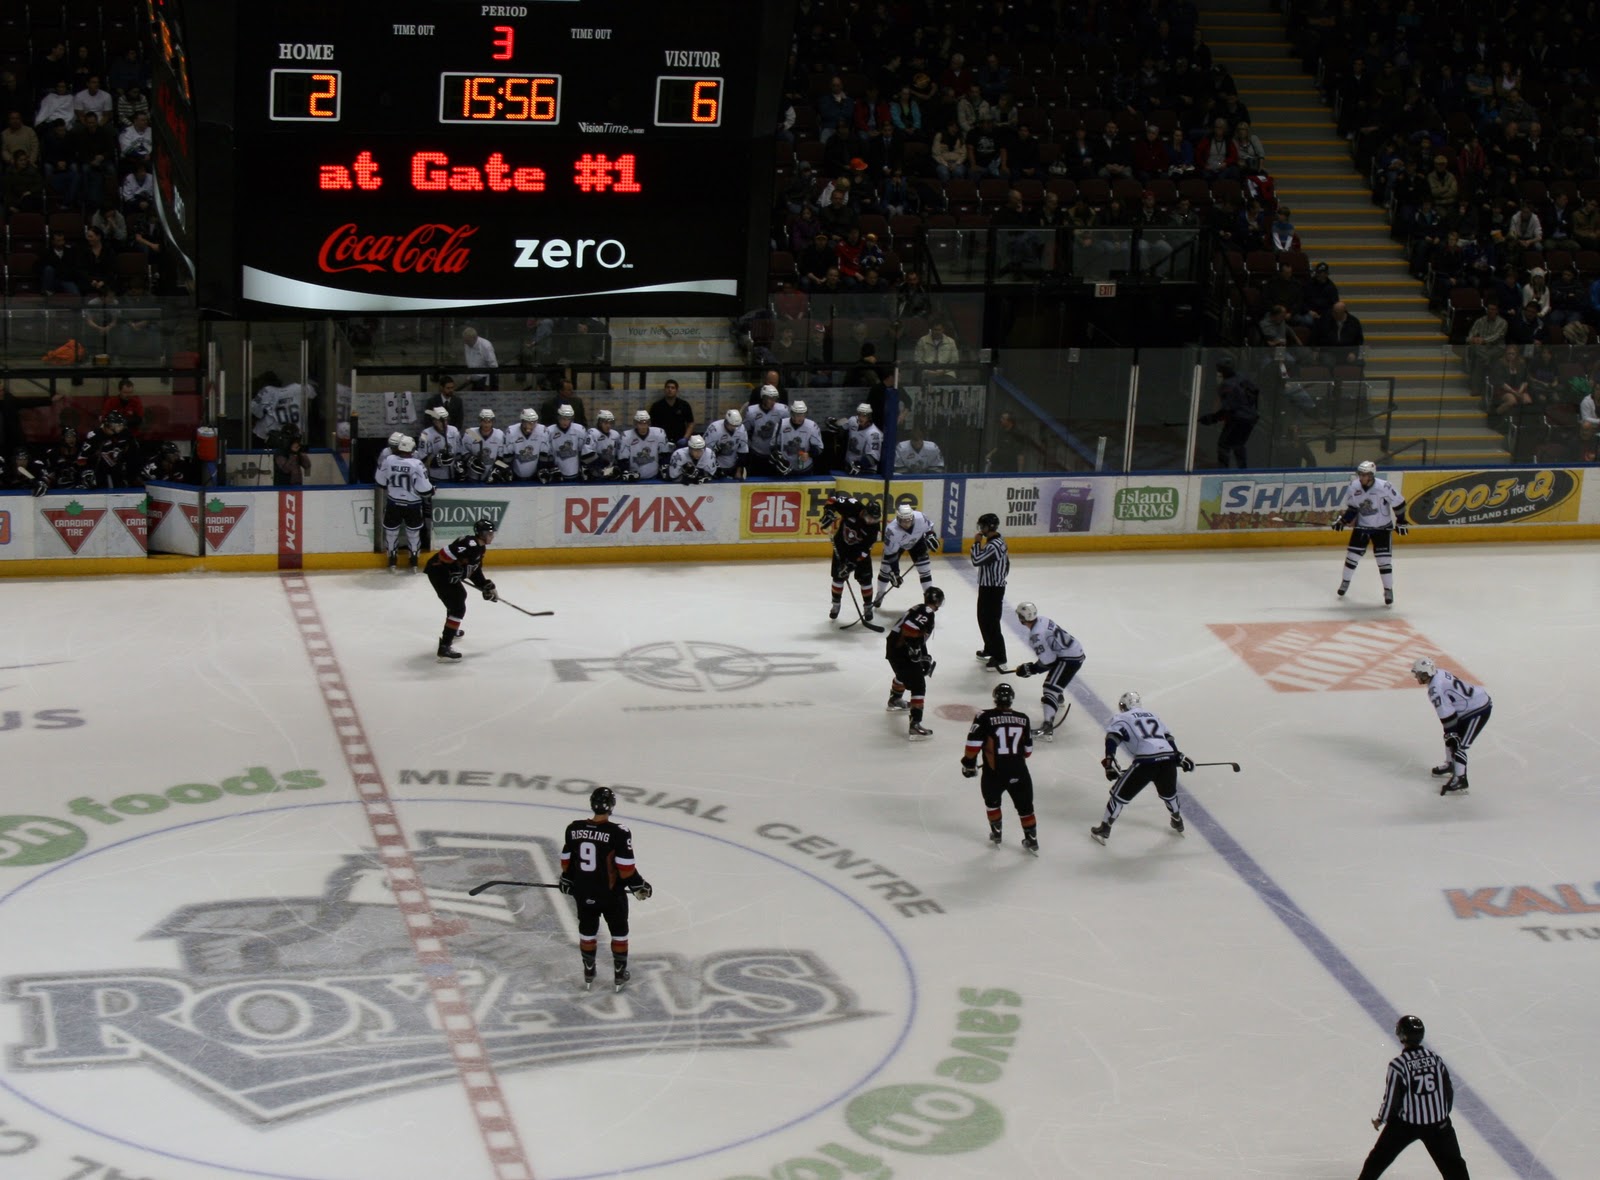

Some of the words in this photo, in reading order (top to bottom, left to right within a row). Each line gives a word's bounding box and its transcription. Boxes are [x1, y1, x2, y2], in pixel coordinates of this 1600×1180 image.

[481, 5, 528, 17] PERIOD
[393, 25, 416, 35] TIME
[418, 25, 435, 36] OUT
[571, 28, 594, 39] TIME
[595, 29, 612, 40] OUT
[278, 43, 335, 61] HOME
[492, 26, 514, 60] 3
[664, 50, 720, 68] VISITOR
[309, 74, 336, 117] 2
[463, 77, 556, 120] 15:56
[692, 80, 718, 123] 6
[318, 150, 384, 191] at
[411, 151, 548, 193] Gate
[573, 152, 643, 193] #1
[513, 237, 627, 269] zero
[1098, 285, 1114, 296] EXIT
[628, 327, 647, 336] Your
[1006, 486, 1040, 500] Drink
[1120, 489, 1173, 504] island
[1225, 485, 1349, 510] SHAW
[431, 506, 502, 523] OLONIST
[947, 481, 960, 536] CCM
[1008, 502, 1037, 514] your
[1117, 503, 1174, 518] FARMS
[1448, 515, 1467, 526] THE
[1510, 503, 1537, 515] ROCK
[54, 518, 95, 528] CANADIAN
[285, 493, 296, 551] CCM
[1005, 513, 1038, 527] milk!
[66, 528, 84, 537] TIRE
[207, 525, 224, 534] TIRE
[916, 613, 929, 625] 12
[1135, 718, 1165, 739] 12
[994, 726, 1023, 755] 17
[67, 766, 327, 826] foods
[399, 768, 728, 824] MEMORIAL
[755, 821, 948, 920] CENTRE
[571, 829, 611, 843] RISSLING
[580, 841, 597, 872] 9
[1517, 926, 1600, 943] Tru
[934, 987, 1023, 1084] save
[1407, 1056, 1437, 1071] FRIESEN
[1413, 1073, 1436, 1094] 76
